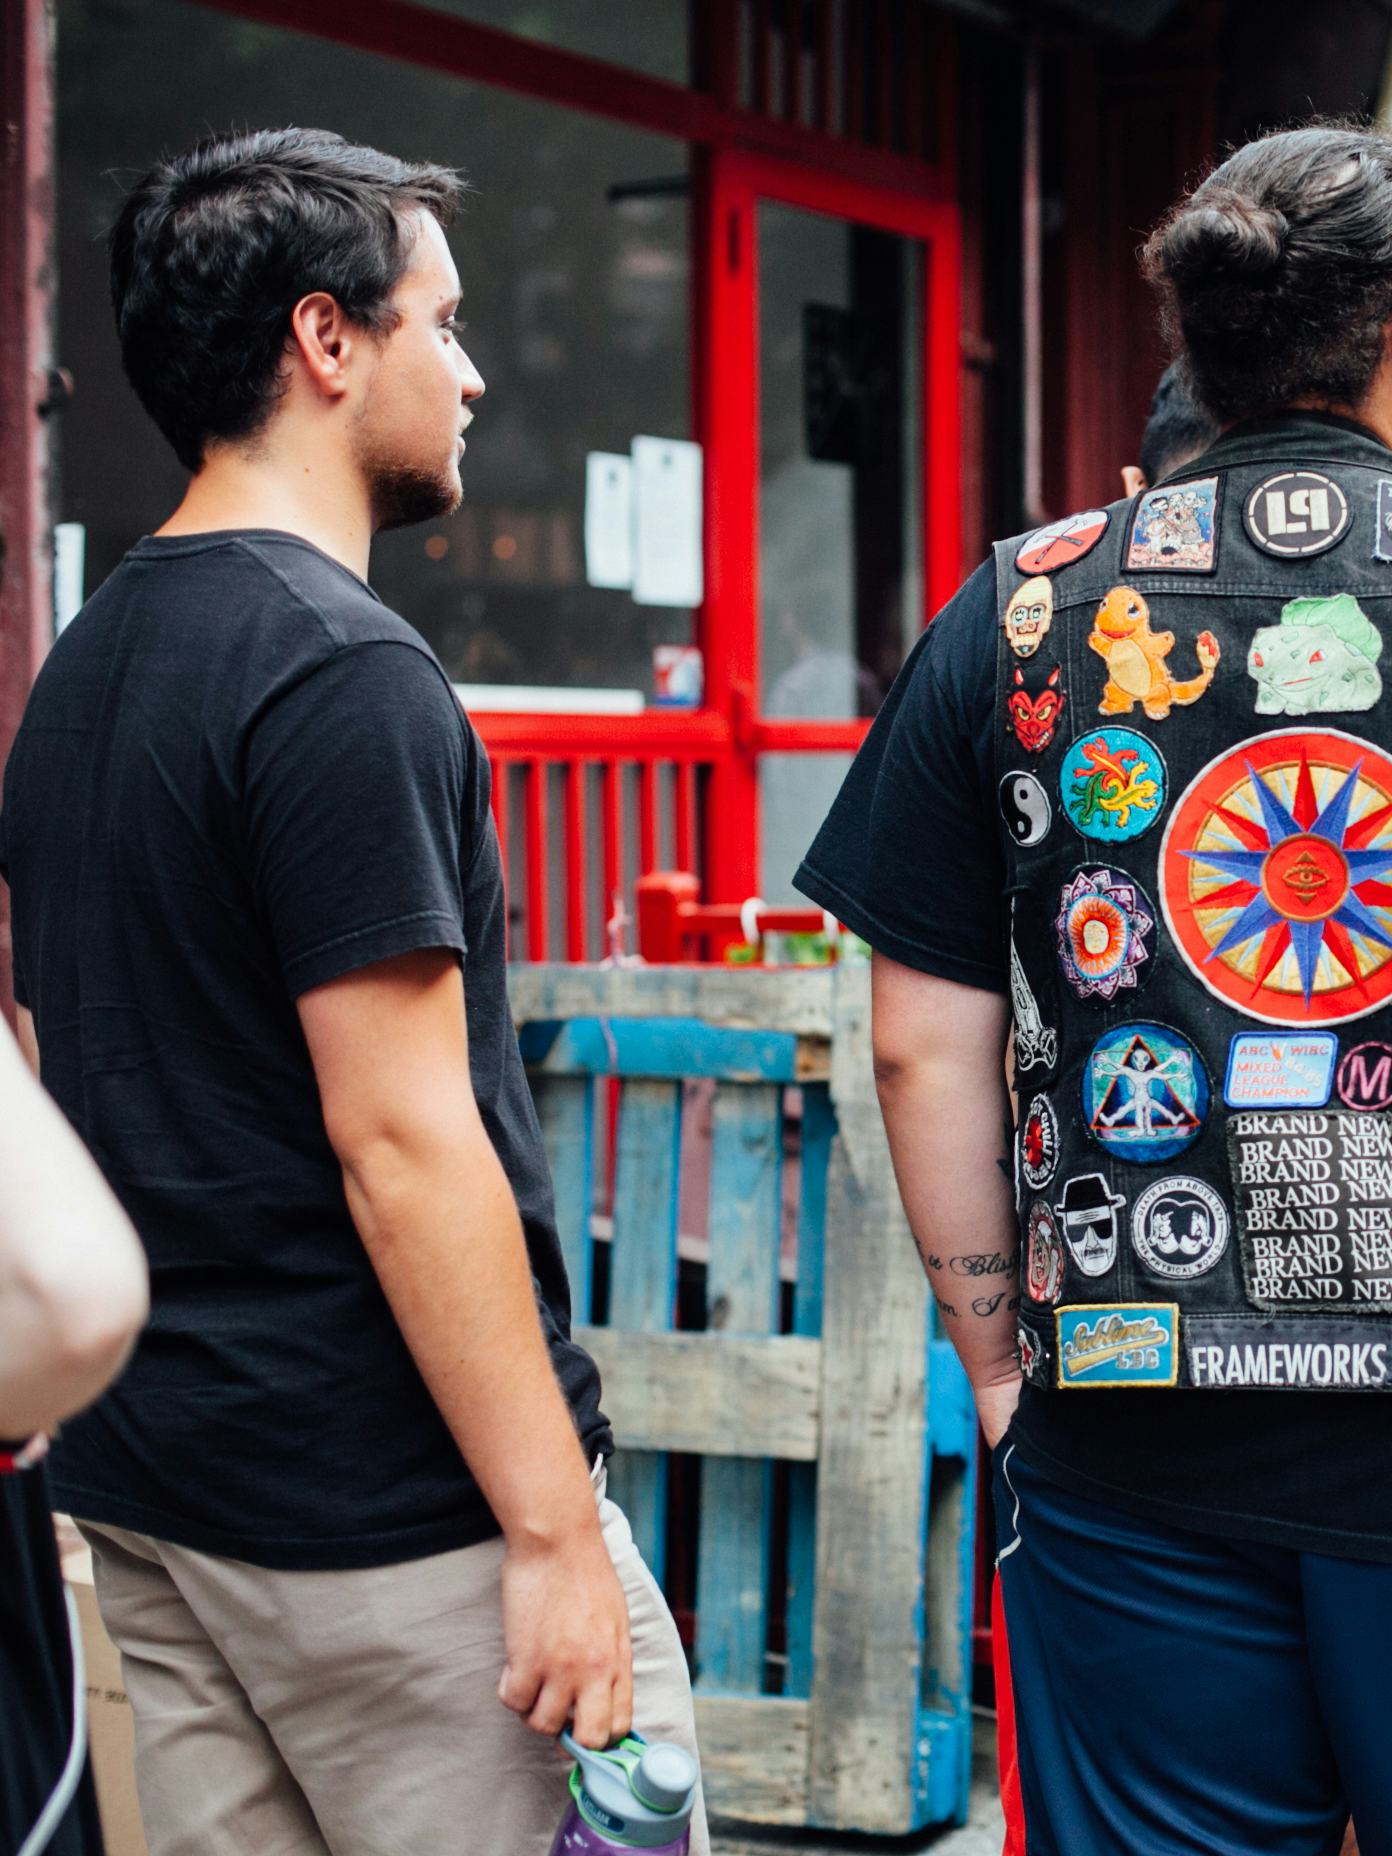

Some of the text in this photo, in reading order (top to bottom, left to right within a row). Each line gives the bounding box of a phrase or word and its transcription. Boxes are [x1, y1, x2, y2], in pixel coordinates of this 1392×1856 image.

[1238, 1044, 1330, 1056] ABC WIBC
[1236, 1062, 1282, 1073] MIXED
[1346, 1055, 1392, 1101] M
[1233, 1075, 1287, 1085] LEAGUE
[1231, 1087, 1310, 1098] CHAMPION
[1235, 1115, 1392, 1137] BRAND NEW
[1240, 1138, 1333, 1163] BRAND
[1239, 1160, 1331, 1184] BRAND
[1138, 1190, 1157, 1216] DEATH
[1158, 1181, 1183, 1191] FROM
[1186, 1181, 1214, 1200] ABOVE
[1250, 1183, 1340, 1209] BRAND
[1245, 1208, 1339, 1230] BRAND
[1138, 1240, 1221, 1273] THE PHYSICAL WORLD
[1252, 1234, 1341, 1258] BRAND
[1255, 1254, 1343, 1279] BRAND
[1252, 1278, 1343, 1300] BRAND
[1065, 1314, 1157, 1356] Sublime
[1116, 1350, 1159, 1369] LBC
[1192, 1344, 1387, 1386] FRAMEWORKS
